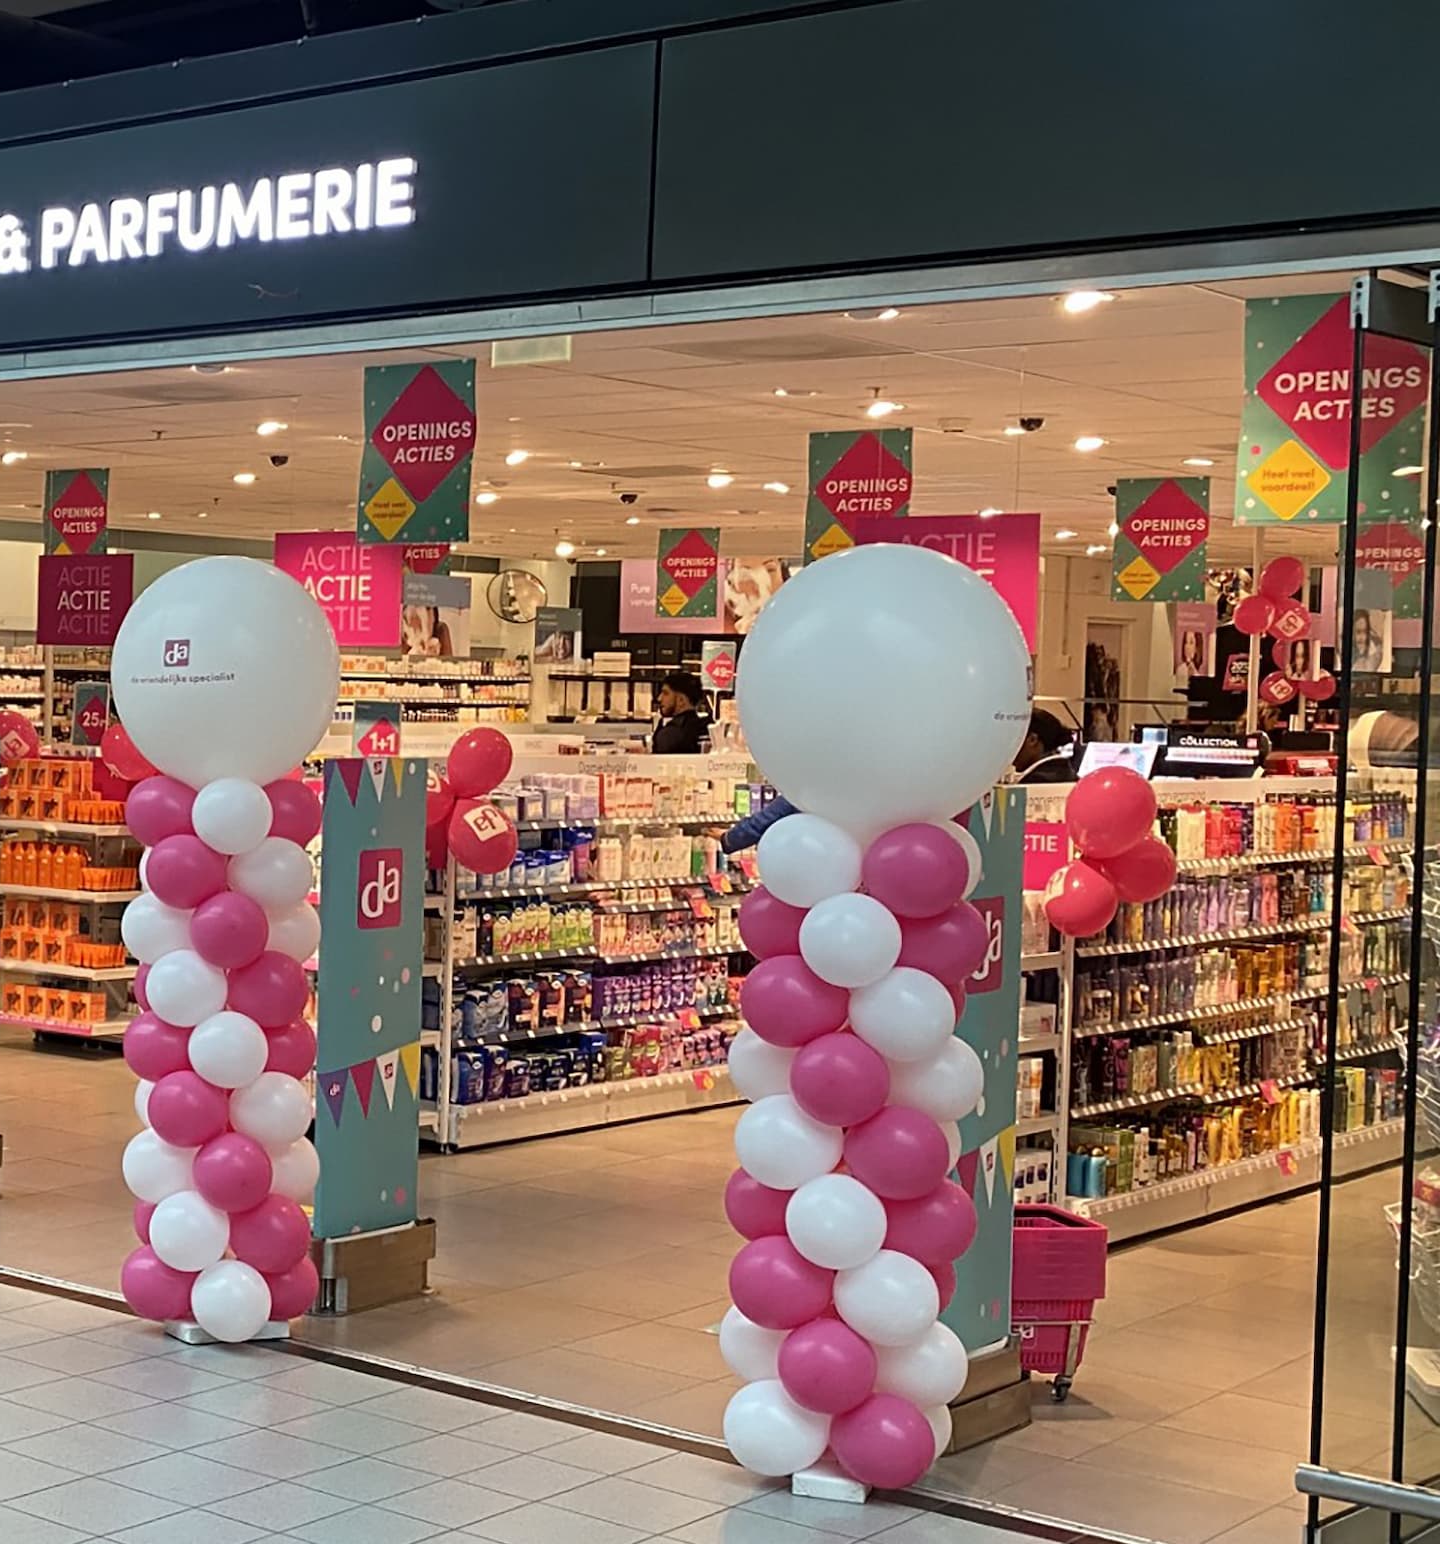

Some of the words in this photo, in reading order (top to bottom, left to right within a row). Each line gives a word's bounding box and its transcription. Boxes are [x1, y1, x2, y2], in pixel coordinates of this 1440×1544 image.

[40, 157, 418, 270] PARFUMERIE
[1274, 366, 1422, 395] OPENNGS
[1293, 397, 1396, 421] ACTES
[383, 421, 472, 442] OPENINGS
[393, 445, 455, 464] ACTIES
[825, 477, 909, 495] OPENINGS
[53, 506, 105, 518] OPENINGS
[836, 497, 893, 513] ACTIES
[62, 521, 97, 534] ACTIES
[1131, 518, 1206, 532] OPENINGS
[1140, 535, 1192, 547] ACTIES
[301, 546, 372, 571] ACTIE
[404, 548, 440, 559] ACTIES
[667, 557, 716, 567] OPENINGS
[58, 565, 111, 587] ACTIE
[673, 569, 708, 578] ACTIES
[303, 576, 372, 601] ACTIE
[57, 590, 111, 611] ACTIE
[58, 614, 110, 635] ACTIE
[323, 606, 371, 631] TIE
[164, 644, 188, 665] da
[189, 672, 235, 684] specialist
[368, 731, 396, 753] 1+1
[1024, 835, 1059, 853] TIE
[361, 860, 400, 919] da
